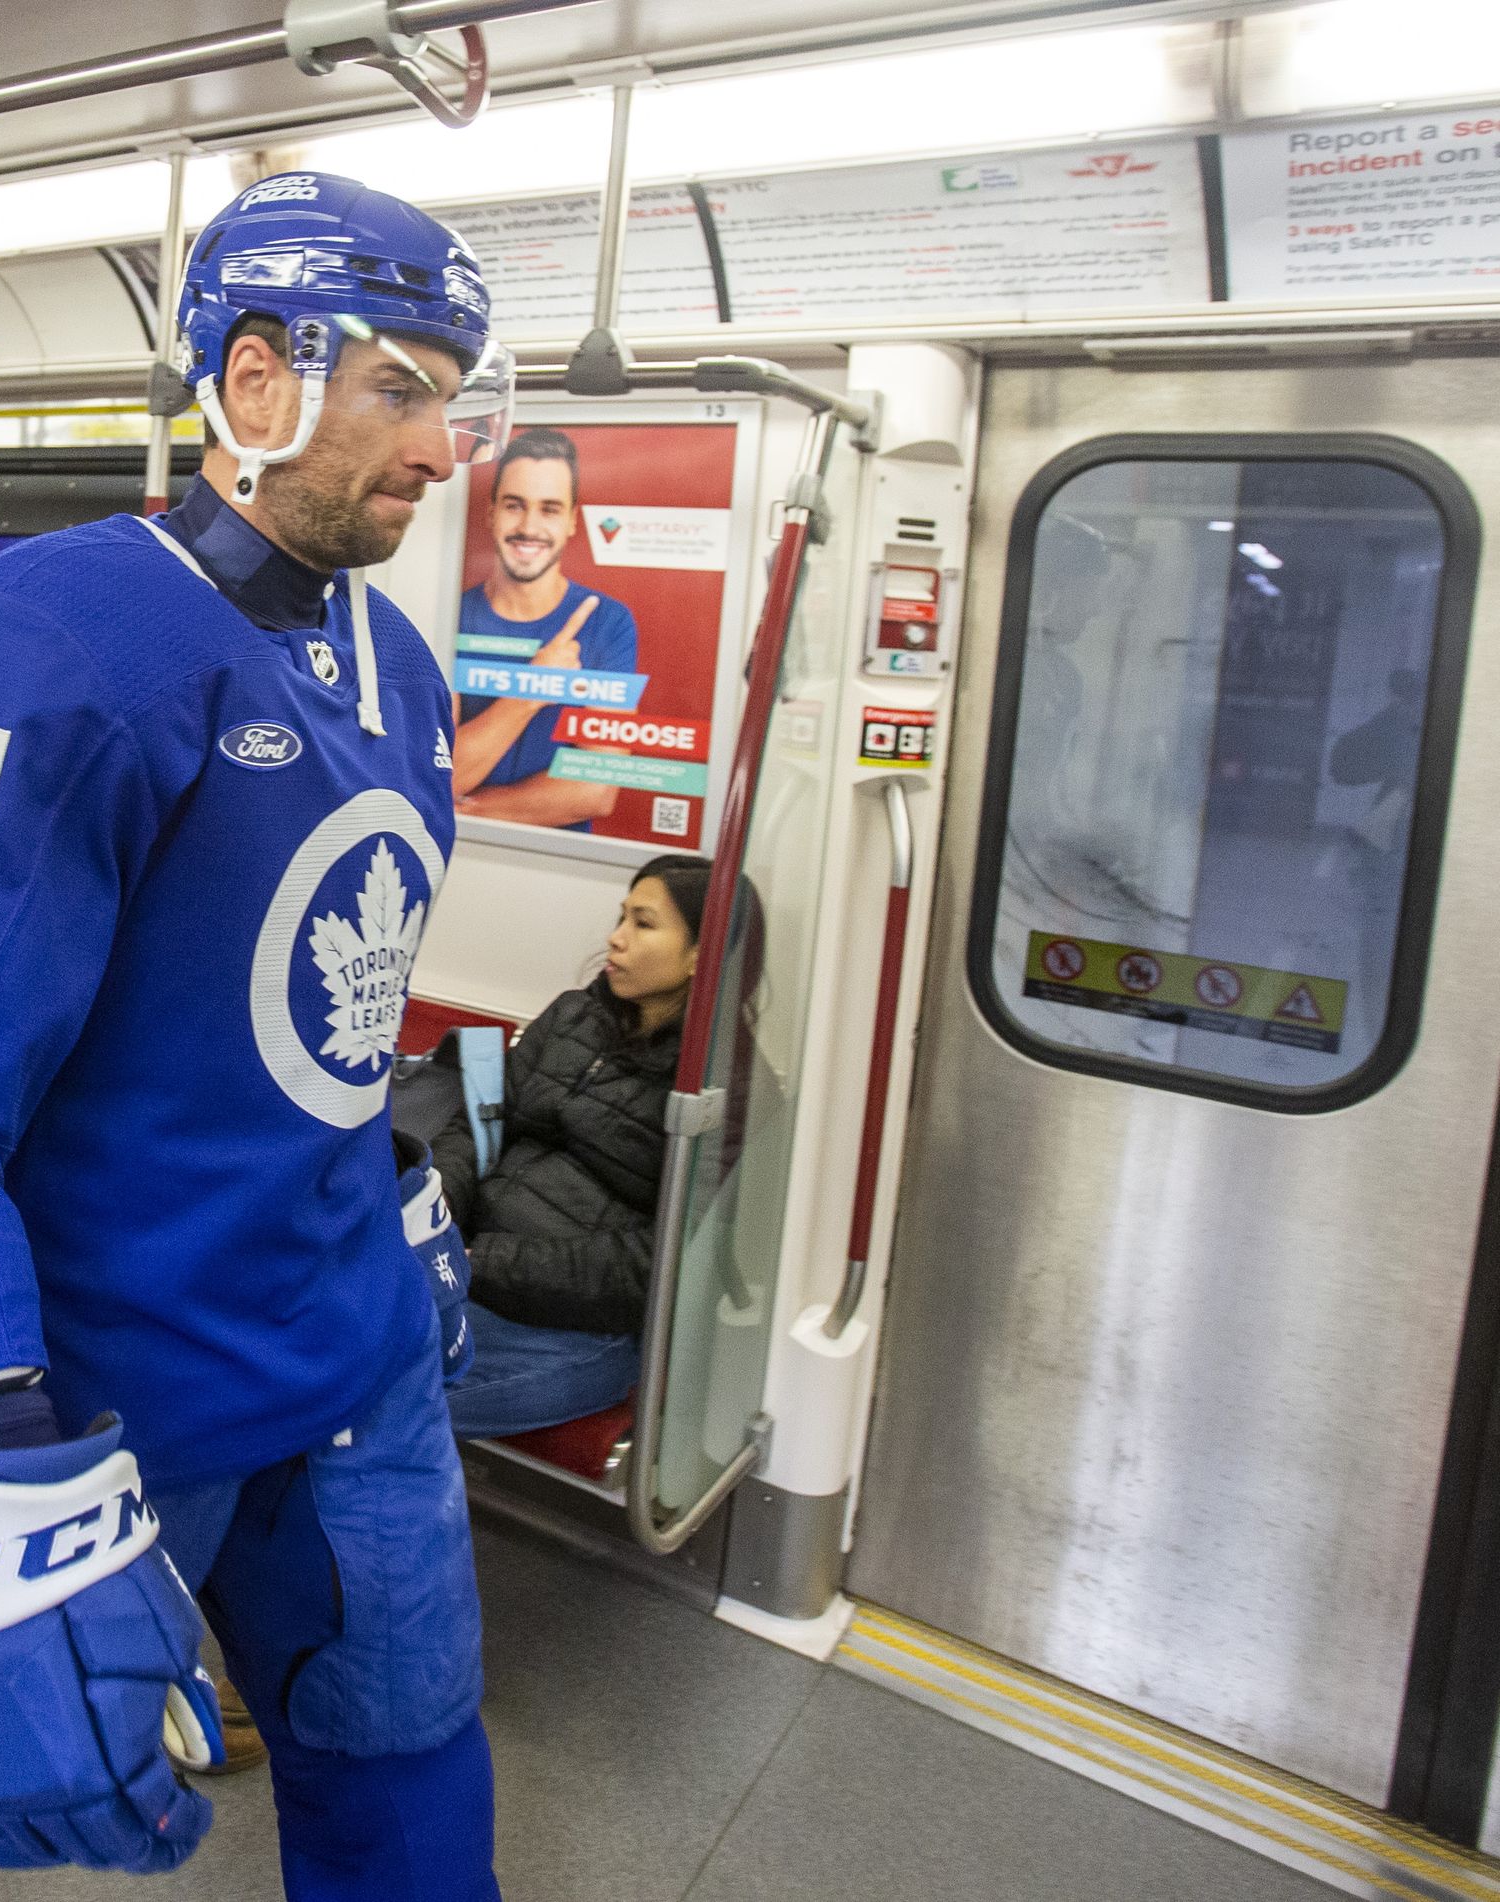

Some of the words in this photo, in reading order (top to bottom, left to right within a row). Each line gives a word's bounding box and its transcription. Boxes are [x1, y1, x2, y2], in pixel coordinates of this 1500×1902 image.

[1289, 125, 1405, 153] Report
[1418, 125, 1438, 141] a
[1453, 119, 1500, 137] se
[1288, 150, 1425, 177] incident
[1436, 146, 1481, 163] on
[240, 185, 320, 211] pizza
[1388, 214, 1453, 231] report
[292, 362, 328, 370] CCM
[705, 404, 725, 418] 13
[467, 667, 511, 691] IT'S
[515, 671, 567, 698] THE
[569, 677, 628, 703] ONE
[237, 728, 288, 760] Ford
[567, 715, 578, 737] I
[581, 717, 696, 750] CHOOSE
[350, 1000, 397, 1031] LEAFS
